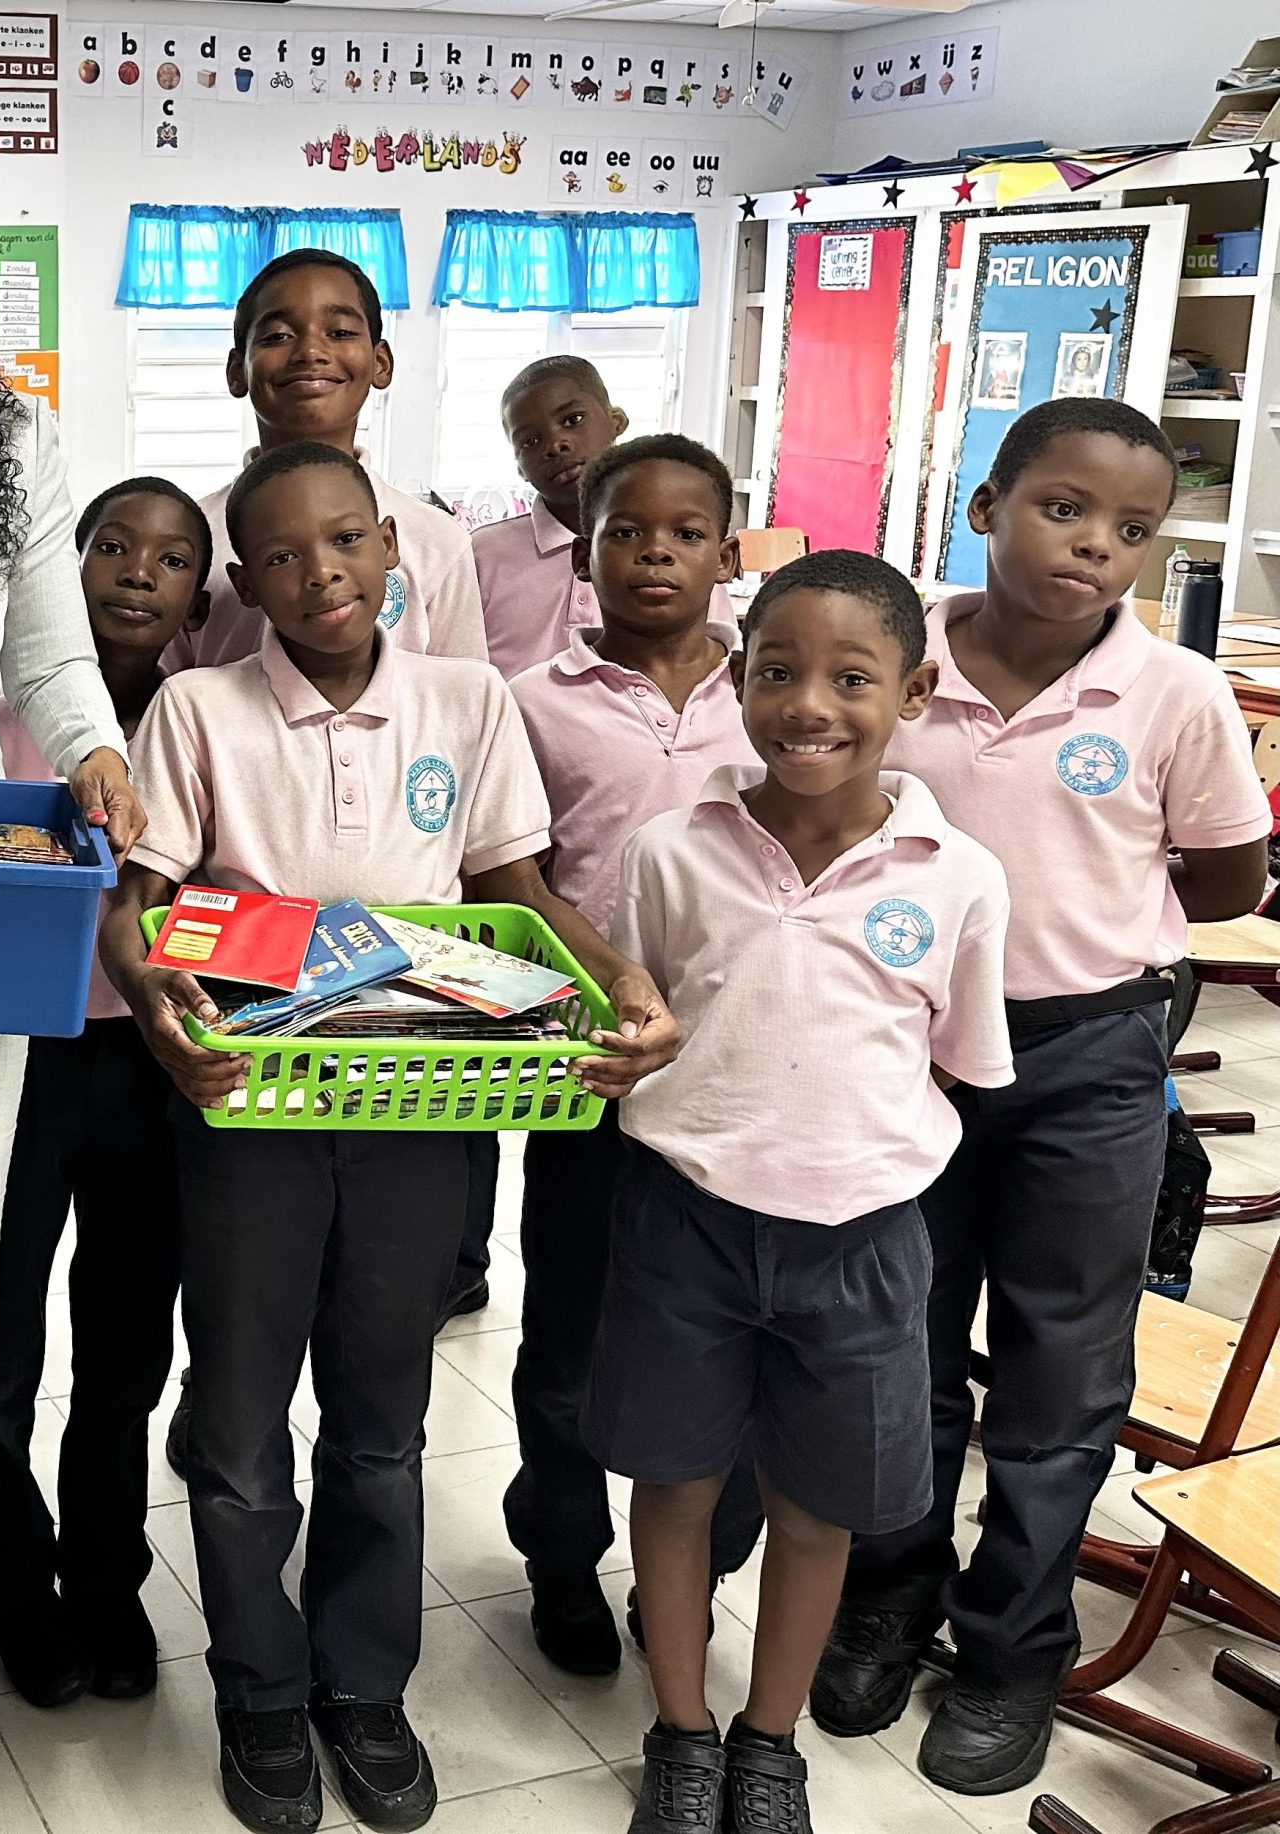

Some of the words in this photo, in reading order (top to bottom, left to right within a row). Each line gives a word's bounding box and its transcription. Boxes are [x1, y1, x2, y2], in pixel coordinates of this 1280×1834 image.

[83, 36, 97, 51] a
[121, 31, 138, 56] b
[163, 40, 176, 57] c
[200, 35, 216, 59] d
[238, 45, 252, 63] e
[277, 39, 288, 63] f
[310, 46, 326, 67] g
[346, 40, 361, 63] h
[382, 41, 389, 64] i
[415, 42, 424, 68] j
[446, 42, 462, 65] k
[486, 44, 493, 67] l
[510, 51, 532, 69] m
[549, 52, 563, 70] n
[581, 55, 595, 72] o
[617, 56, 632, 77] p
[650, 59, 665, 80] q
[686, 61, 697, 78] r
[720, 62, 730, 80] s
[755, 60, 766, 81] t
[777, 71, 793, 90] u
[852, 64, 865, 81] v
[876, 59, 894, 77] w
[908, 53, 922, 71] x
[941, 43, 955, 68] ij
[970, 43, 983, 61] z
[162, 99, 174, 116] c
[304, 129, 523, 174] NEDERLANDS
[558, 149, 588, 167] aa
[605, 149, 631, 167] ee
[649, 154, 676, 171] oo
[692, 155, 721, 171] uu
[986, 255, 1130, 288] RELIGION
[339, 920, 383, 955] ERIC'S
